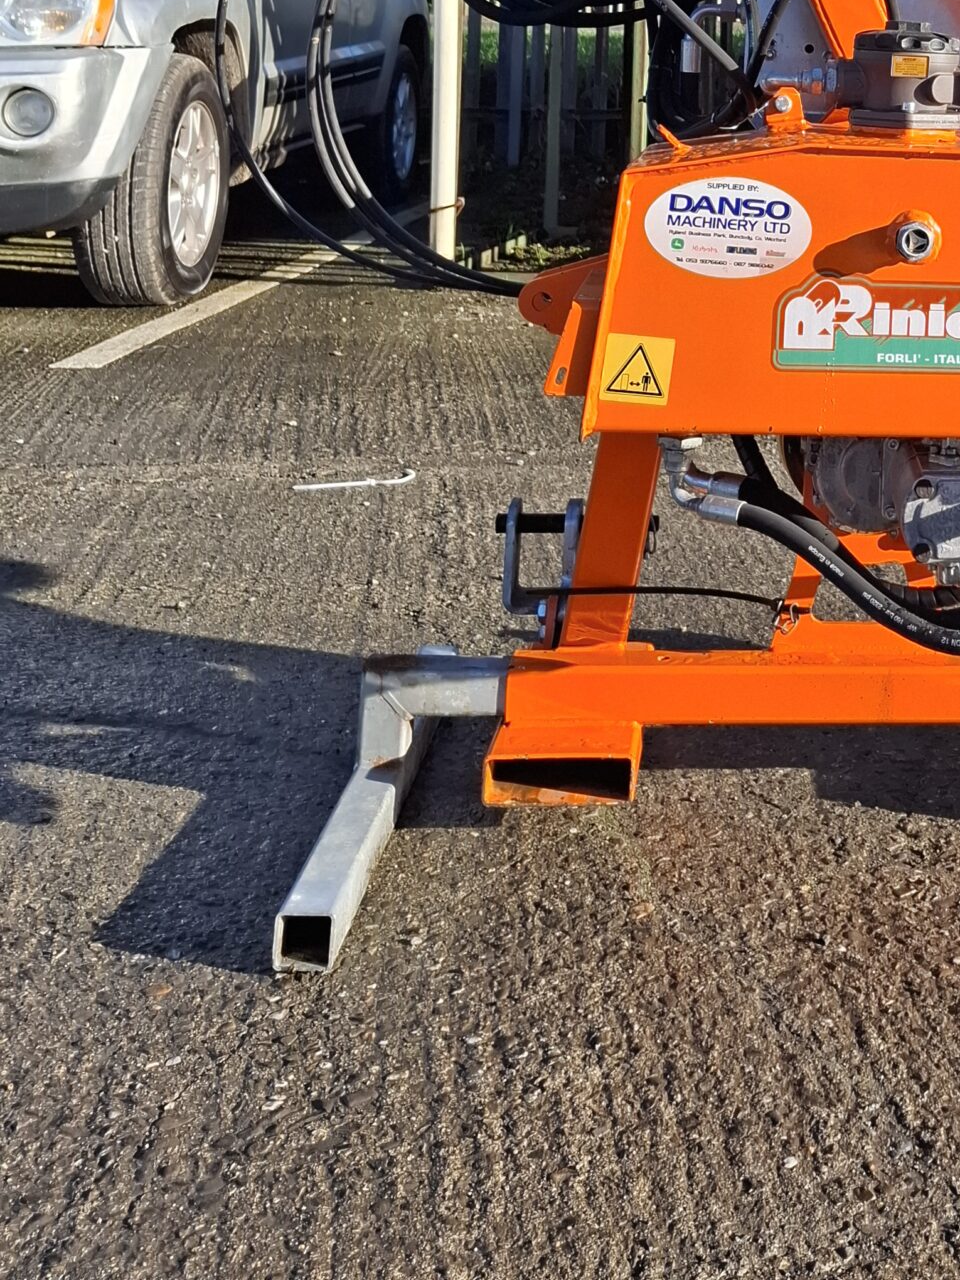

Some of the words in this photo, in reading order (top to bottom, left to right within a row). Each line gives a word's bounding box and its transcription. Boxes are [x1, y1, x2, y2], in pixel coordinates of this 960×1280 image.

[707, 182, 745, 191] SUPPLIED
[668, 193, 792, 220] DANSO
[666, 214, 759, 232] MACHINERY
[763, 221, 791, 235] LTD
[876, 352, 921, 364] FORLI'
